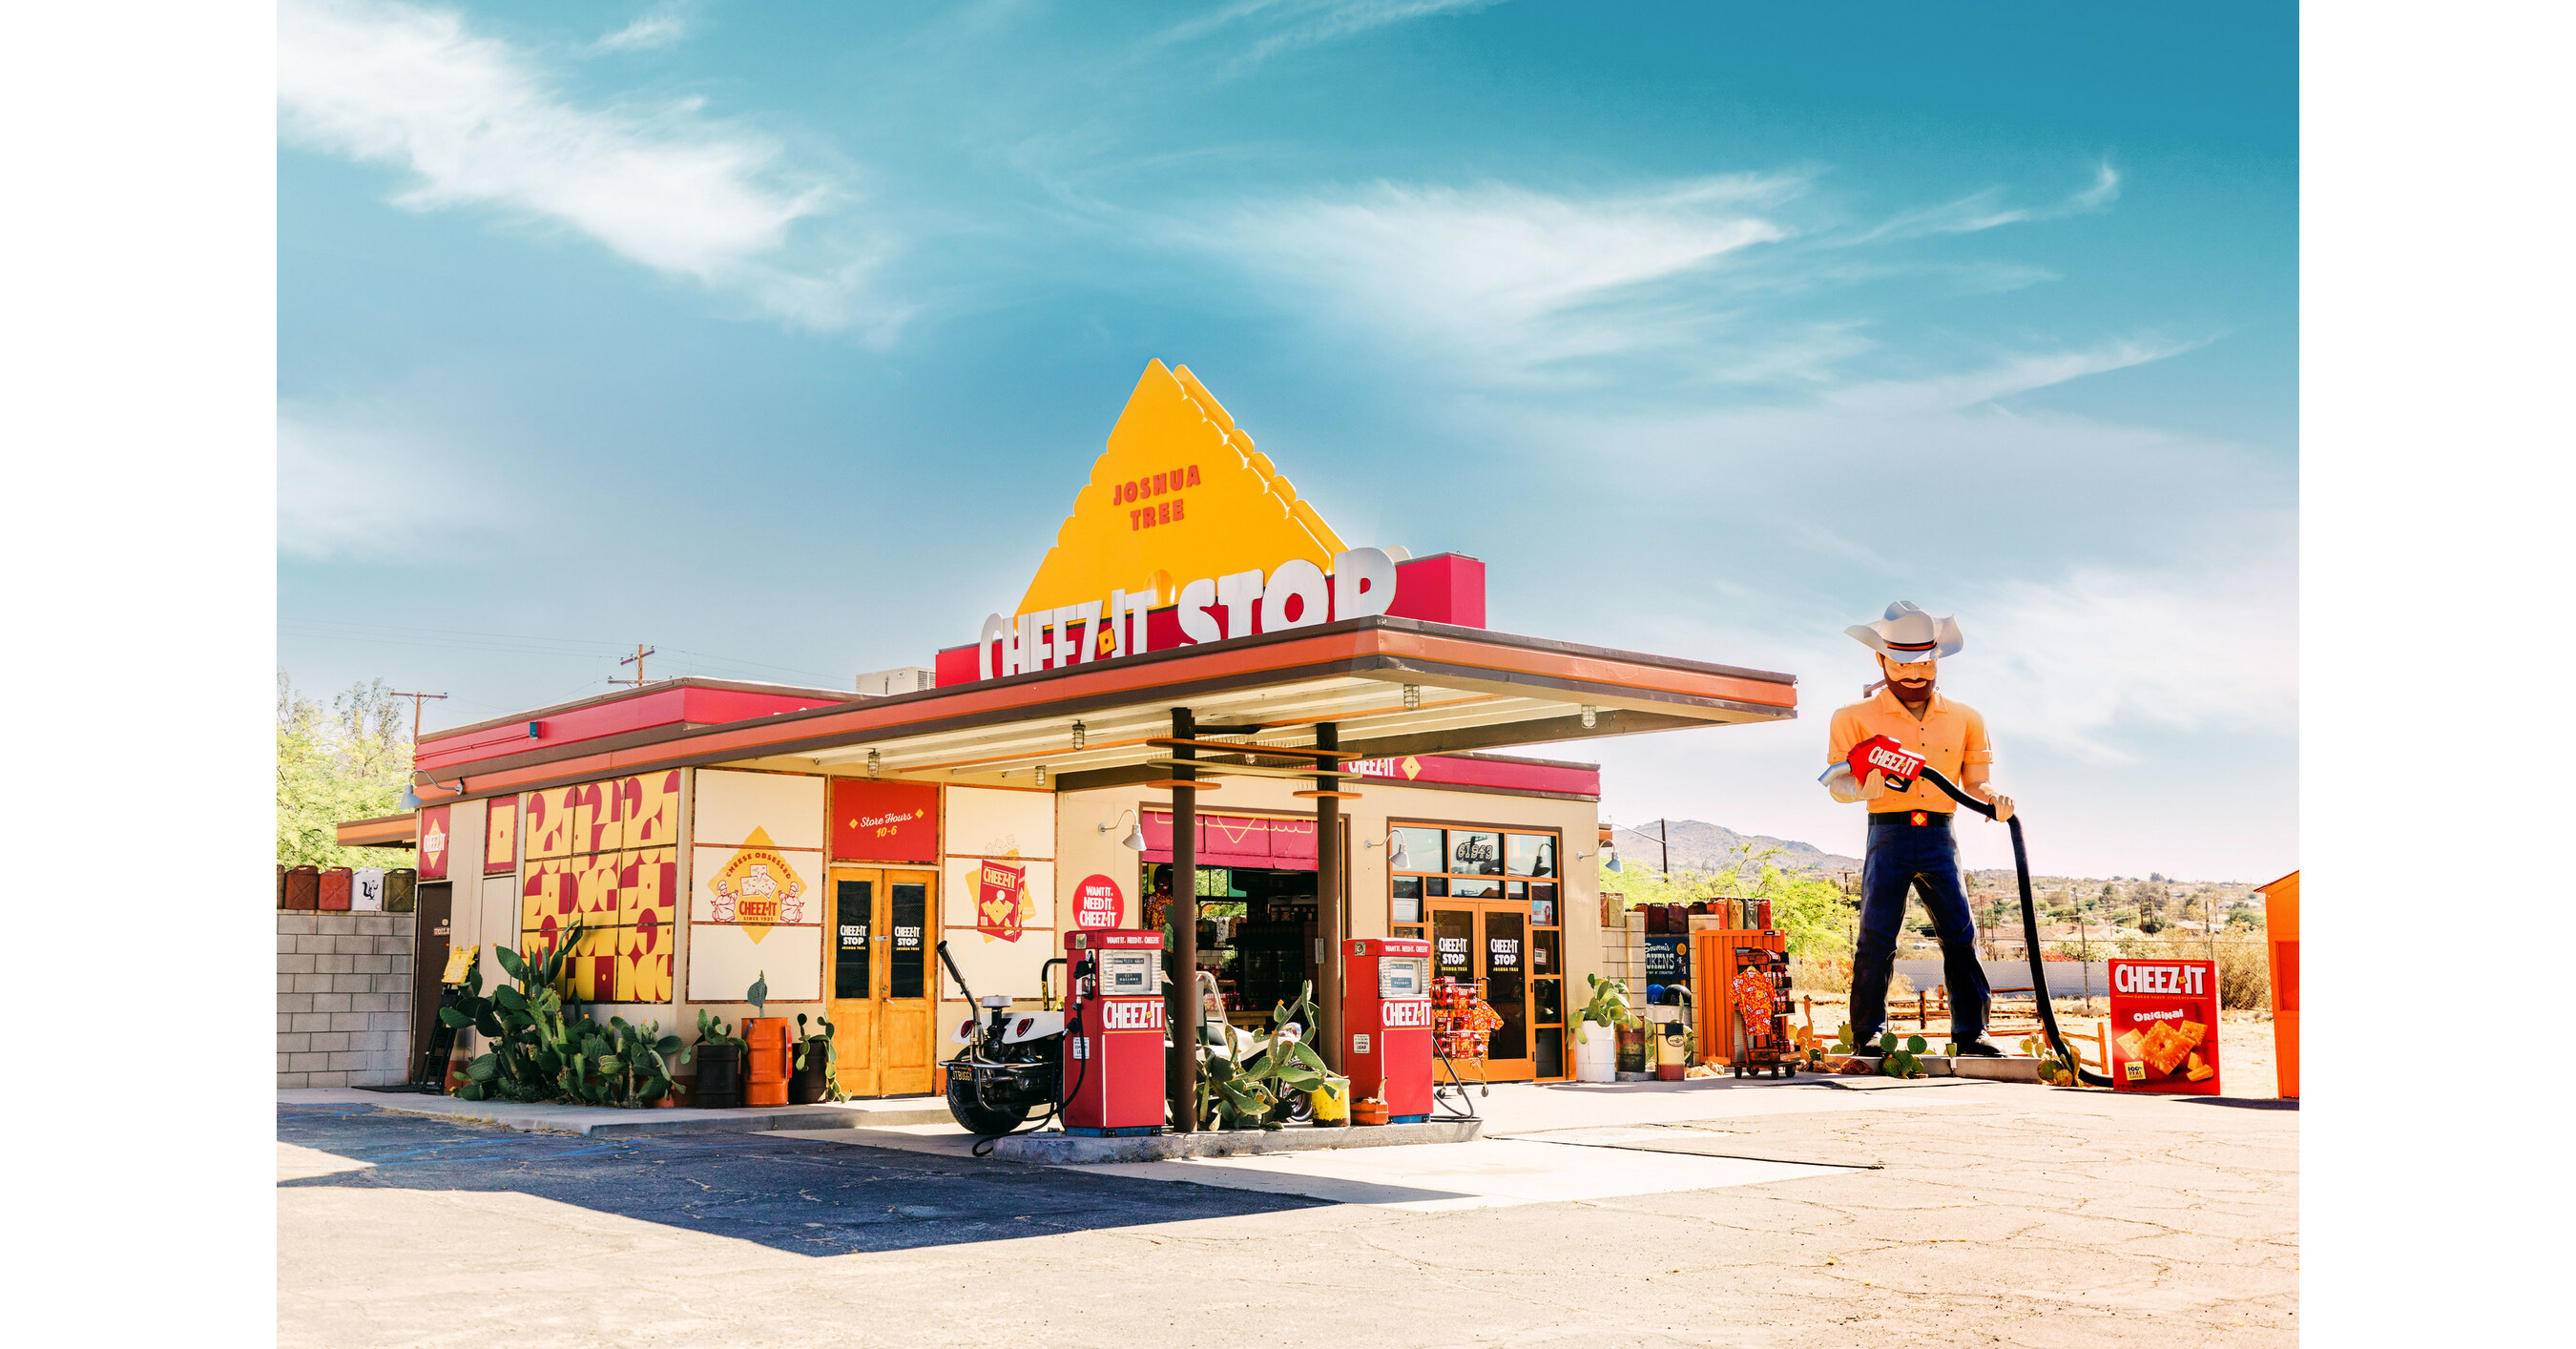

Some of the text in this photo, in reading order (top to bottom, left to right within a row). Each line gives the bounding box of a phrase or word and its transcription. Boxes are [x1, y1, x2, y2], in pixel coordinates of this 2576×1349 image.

[1113, 465, 1201, 506] JOSHUA
[1130, 499, 1184, 531] TREE
[1177, 547, 1397, 647] STOP
[1868, 746, 1920, 777] CHEEZ-IT
[861, 813, 913, 828] Store Hours
[876, 825, 898, 838] 10-6
[1456, 843, 1493, 861] 61943
[725, 852, 791, 880] CHEESE OBSESSED
[983, 867, 1017, 889] CHEEZ-IT
[1086, 885, 1105, 897] WANT
[738, 901, 778, 916] CHEEZ-IT
[1083, 897, 1104, 910] NEED
[1079, 910, 1117, 927] CHEEZ-IT
[840, 924, 867, 937] CHEEZ-IT
[894, 925, 921, 938] CHEEZ-IT
[842, 937, 864, 945] STOP
[897, 938, 919, 946] STOP
[1438, 937, 1467, 953] CHEEZ-IT
[1490, 939, 1519, 953] CHEEZ-IT
[1645, 942, 1672, 953] Souvenir
[1442, 953, 1465, 965] STOP
[1494, 954, 1516, 965] STOP
[1646, 953, 1675, 970] OKENS
[2114, 964, 2206, 994] CHEEZ-IT
[1102, 1001, 1164, 1029] CHEEZ-IT
[1382, 1001, 1432, 1027] CHEEZ-IT
